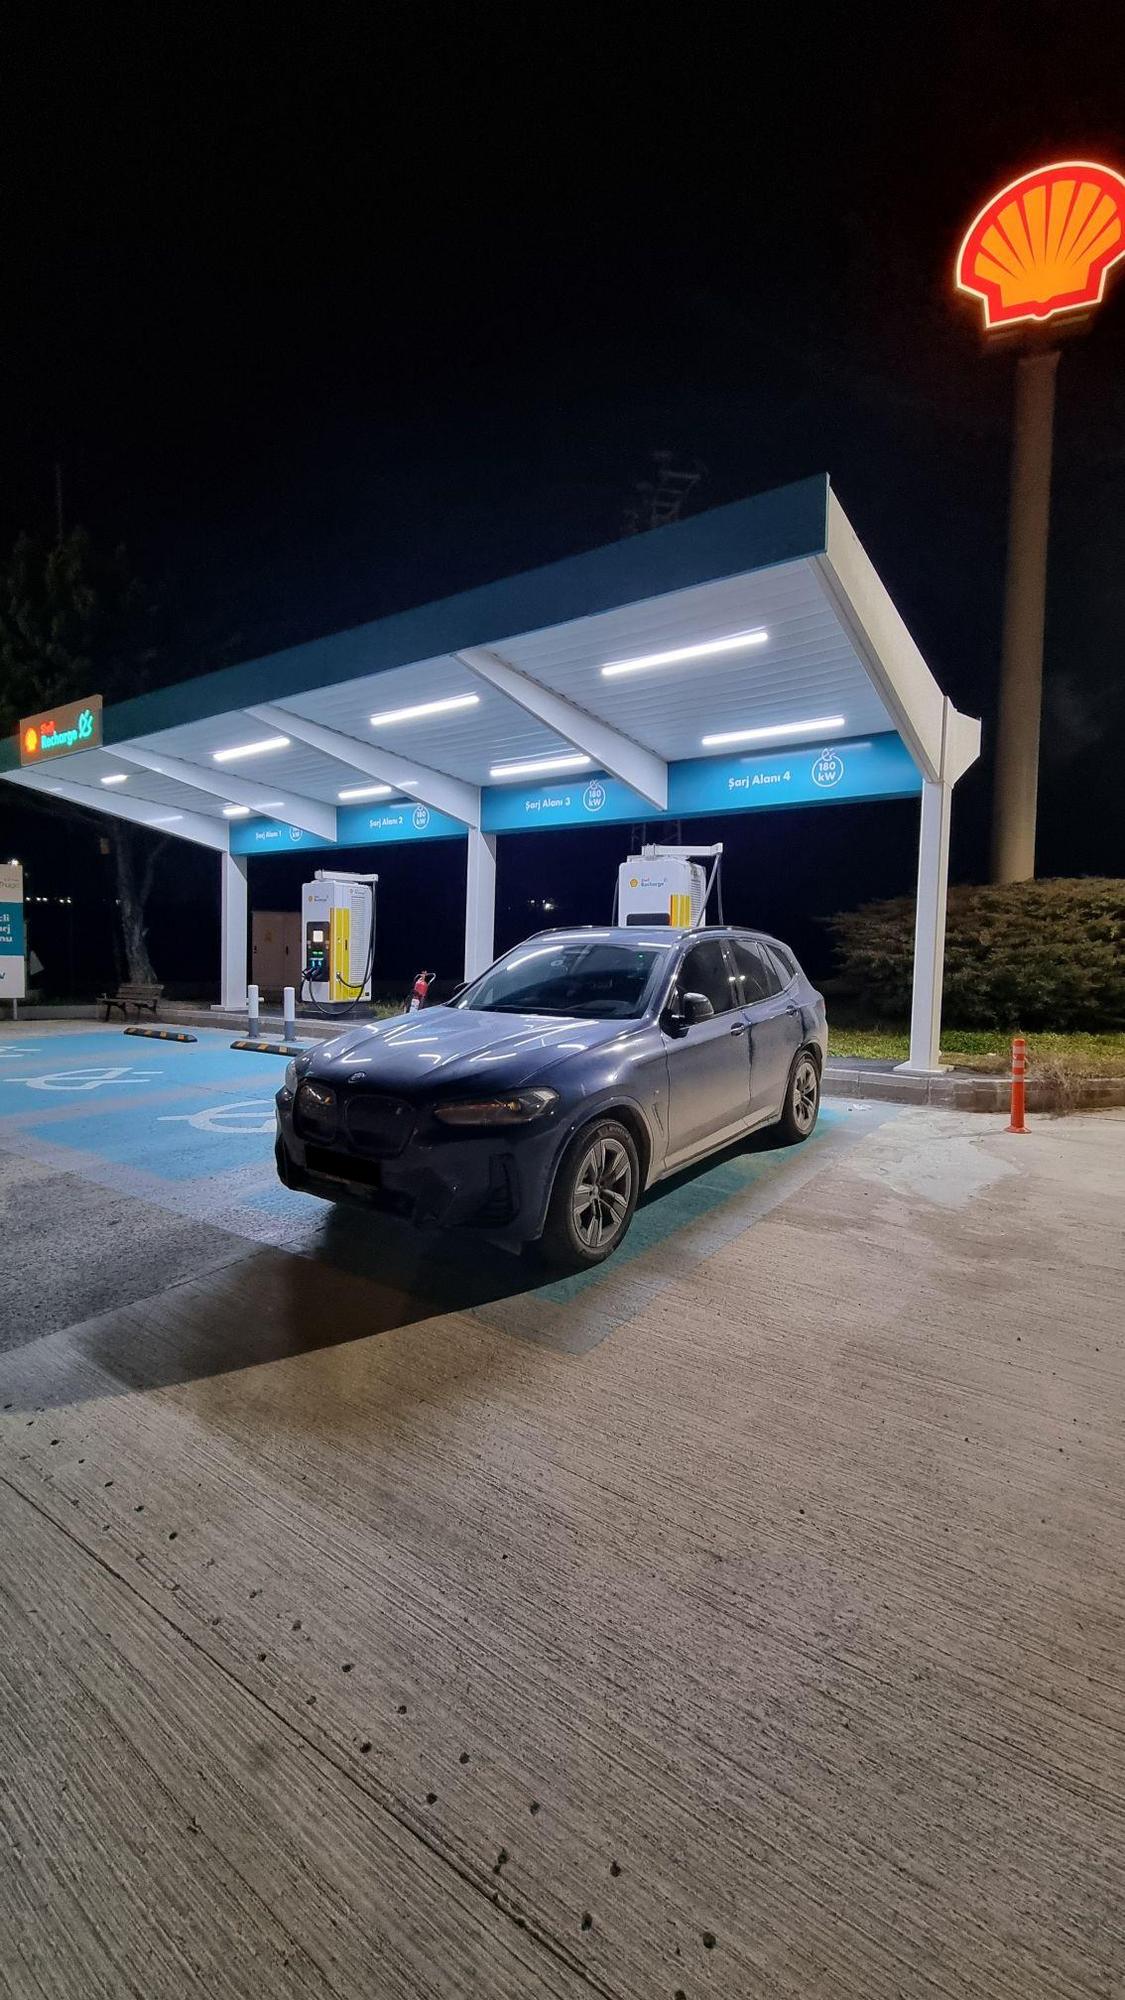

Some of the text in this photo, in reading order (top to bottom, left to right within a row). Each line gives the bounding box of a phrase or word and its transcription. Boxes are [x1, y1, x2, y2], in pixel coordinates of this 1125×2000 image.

[819, 762, 836, 771] 180
[728, 771, 791, 791] Şarj Alanı 4
[817, 772, 836, 782] kW
[589, 790, 602, 798] 180
[525, 800, 541, 812] Şarj
[565, 797, 571, 806] 3
[588, 798, 602, 806] kW
